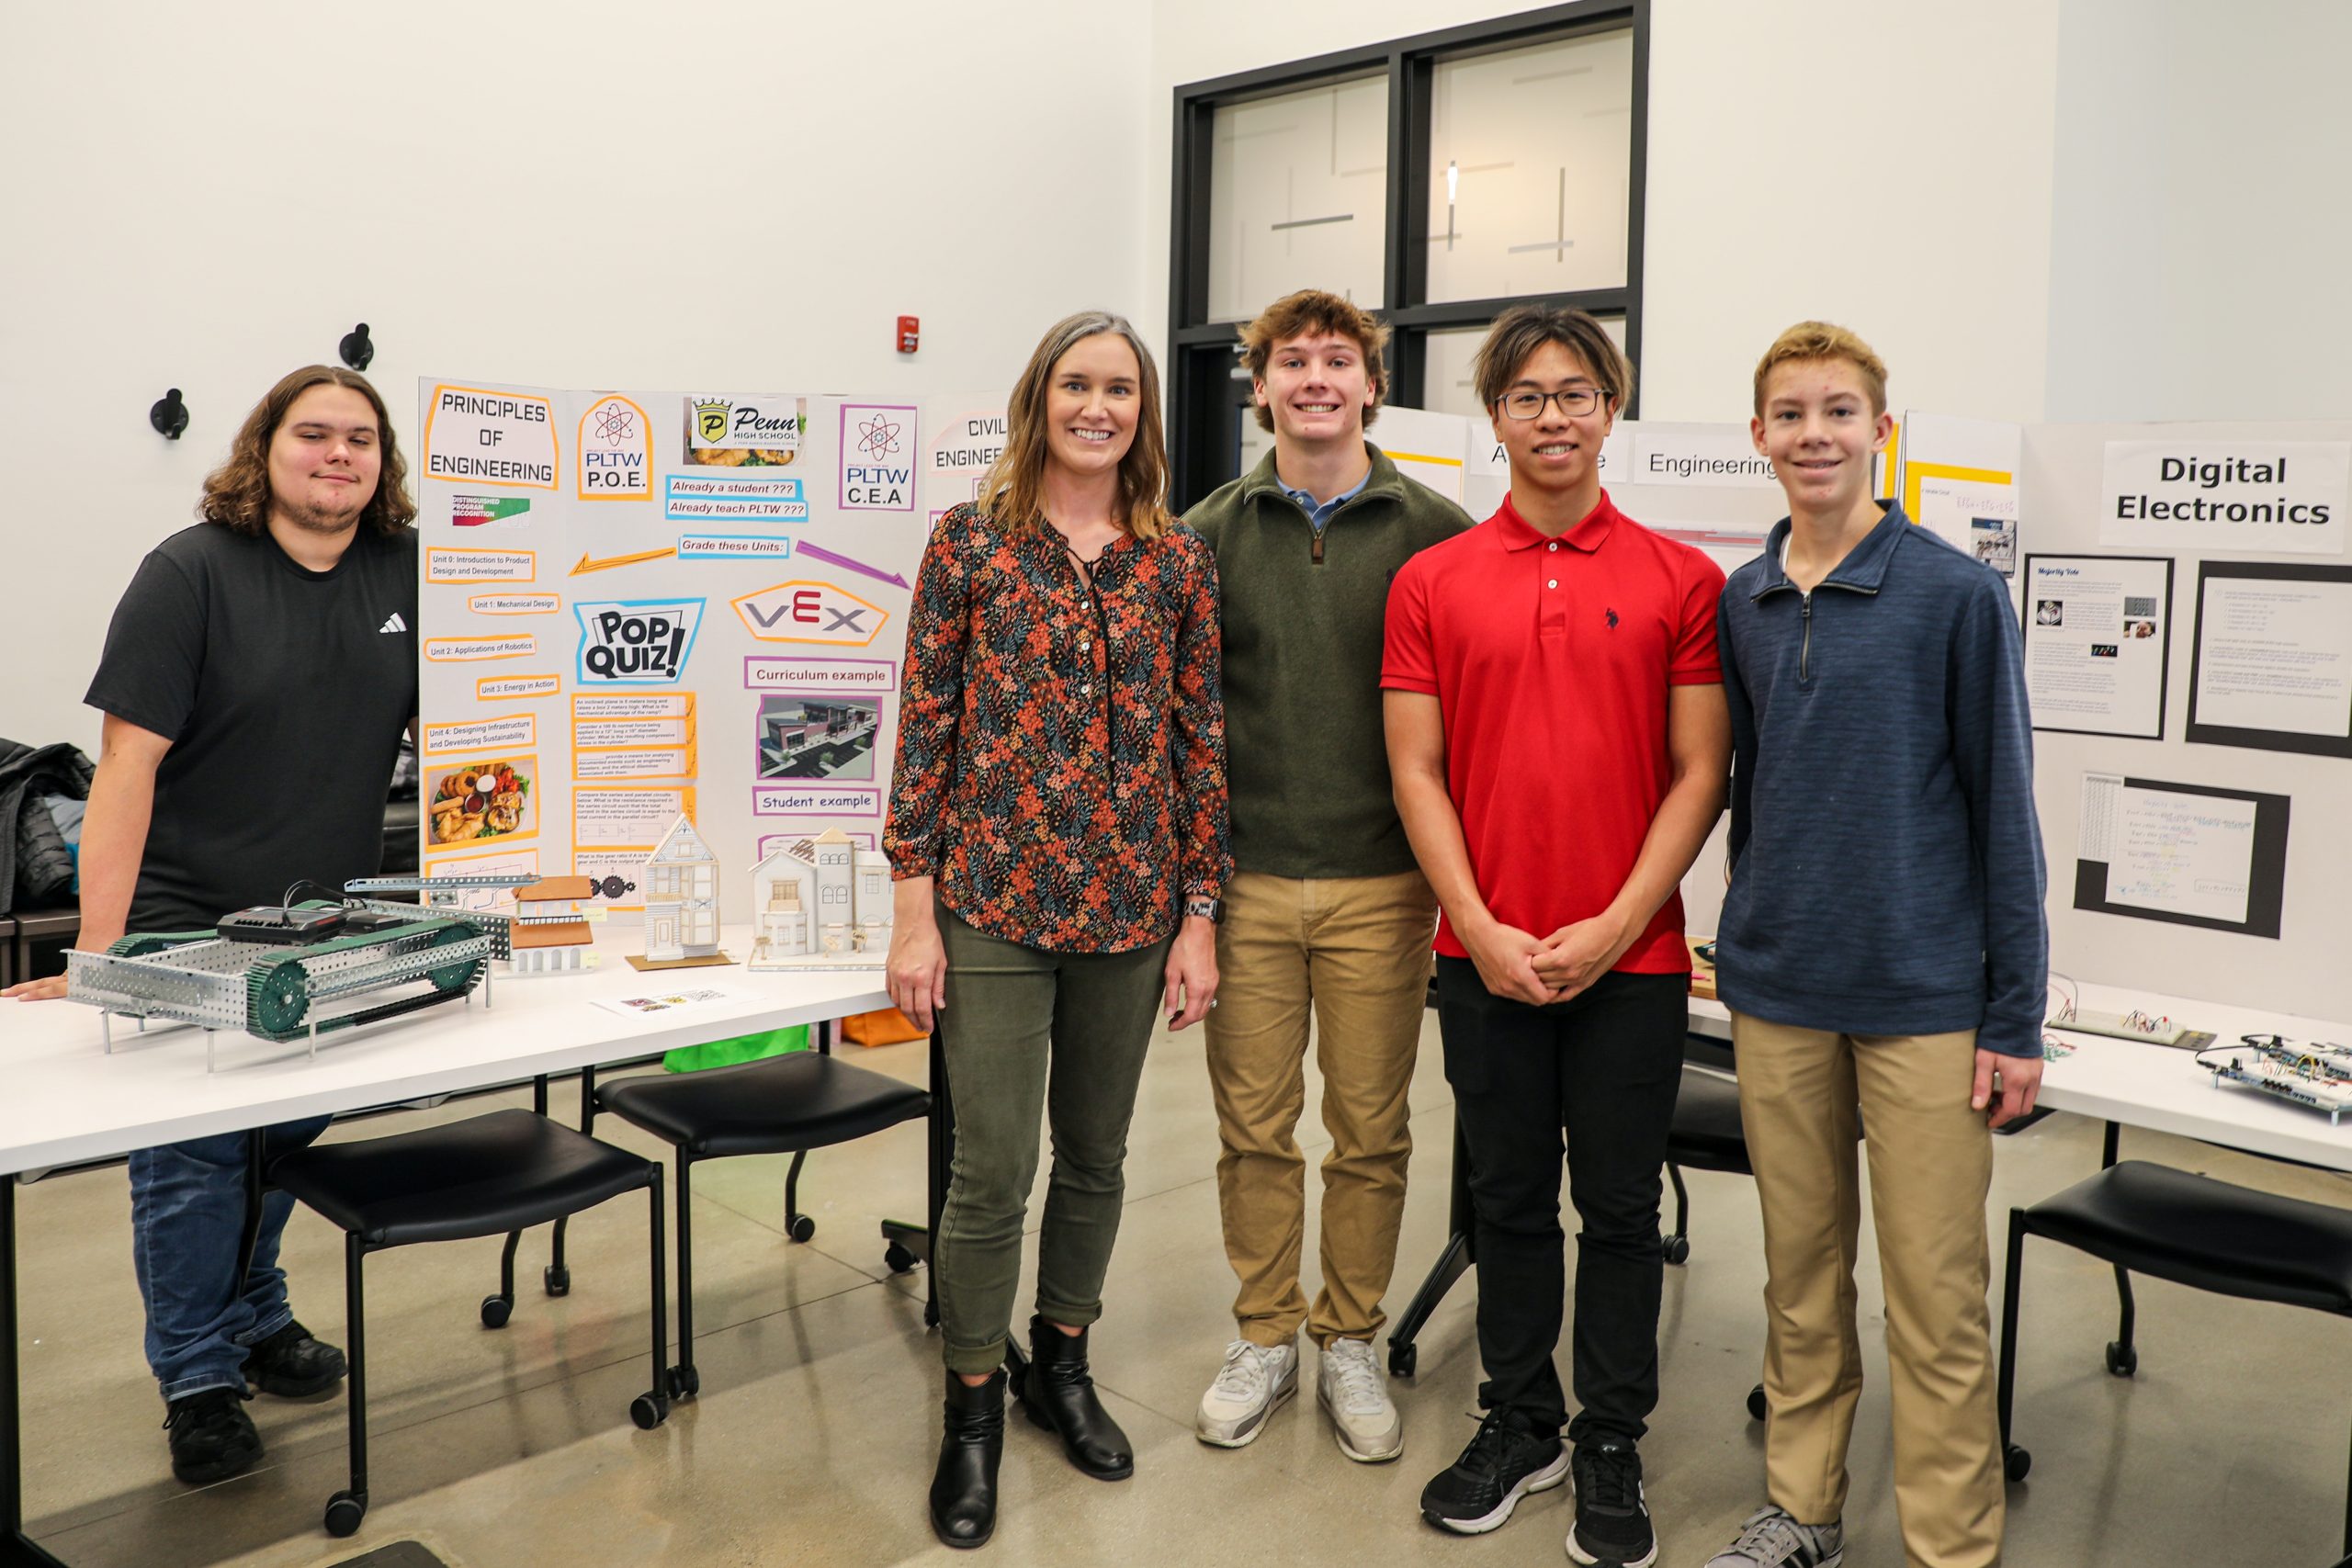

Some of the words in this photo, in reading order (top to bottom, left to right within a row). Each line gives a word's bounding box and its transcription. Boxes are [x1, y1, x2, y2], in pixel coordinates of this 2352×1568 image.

[442, 393, 546, 422] PRINCIPLES
[735, 407, 796, 432] Penn
[968, 418, 1007, 436] CIVIL
[480, 429, 503, 446] OF
[734, 432, 756, 440] HIGH
[758, 432, 796, 440] SCHOOL
[430, 455, 552, 481] ENGINEERING
[586, 453, 642, 468] PLTW
[1650, 453, 1778, 479] Engineering
[588, 471, 646, 487] P.O.E.
[847, 468, 909, 484] PLTW
[2161, 457, 2286, 489] Digital
[672, 481, 716, 493] Already
[728, 483, 769, 494] student
[772, 485, 793, 494] ???
[848, 488, 901, 504] C.E.A
[670, 502, 714, 514] Already
[716, 503, 745, 513] teach
[748, 504, 781, 514] PLTW
[784, 505, 804, 515] ???
[2117, 494, 2331, 525] Electronics
[683, 540, 716, 550] Grade
[718, 541, 749, 551] these
[752, 542, 784, 552] Units:
[433, 556, 447, 564] Unit
[447, 556, 455, 564] 0:
[456, 556, 496, 564] Introduction
[433, 567, 457, 576] Design
[471, 568, 514, 576] Development
[497, 600, 532, 608] Mechanical
[534, 600, 554, 608] Design
[745, 591, 866, 633] VEX
[599, 611, 670, 645] POP
[455, 645, 495, 655] Applications
[504, 642, 532, 650] Robotics
[586, 628, 685, 679] QUIZ!
[756, 670, 828, 681] Curriculum
[831, 671, 886, 682] example
[504, 683, 526, 693] Energy
[535, 681, 554, 689] Action
[453, 727, 486, 736] Designing
[488, 721, 530, 731] Infrastructure
[444, 738, 481, 748] Developing
[483, 732, 525, 742] Sustainability
[763, 796, 813, 808] Student
[820, 795, 871, 807] example
